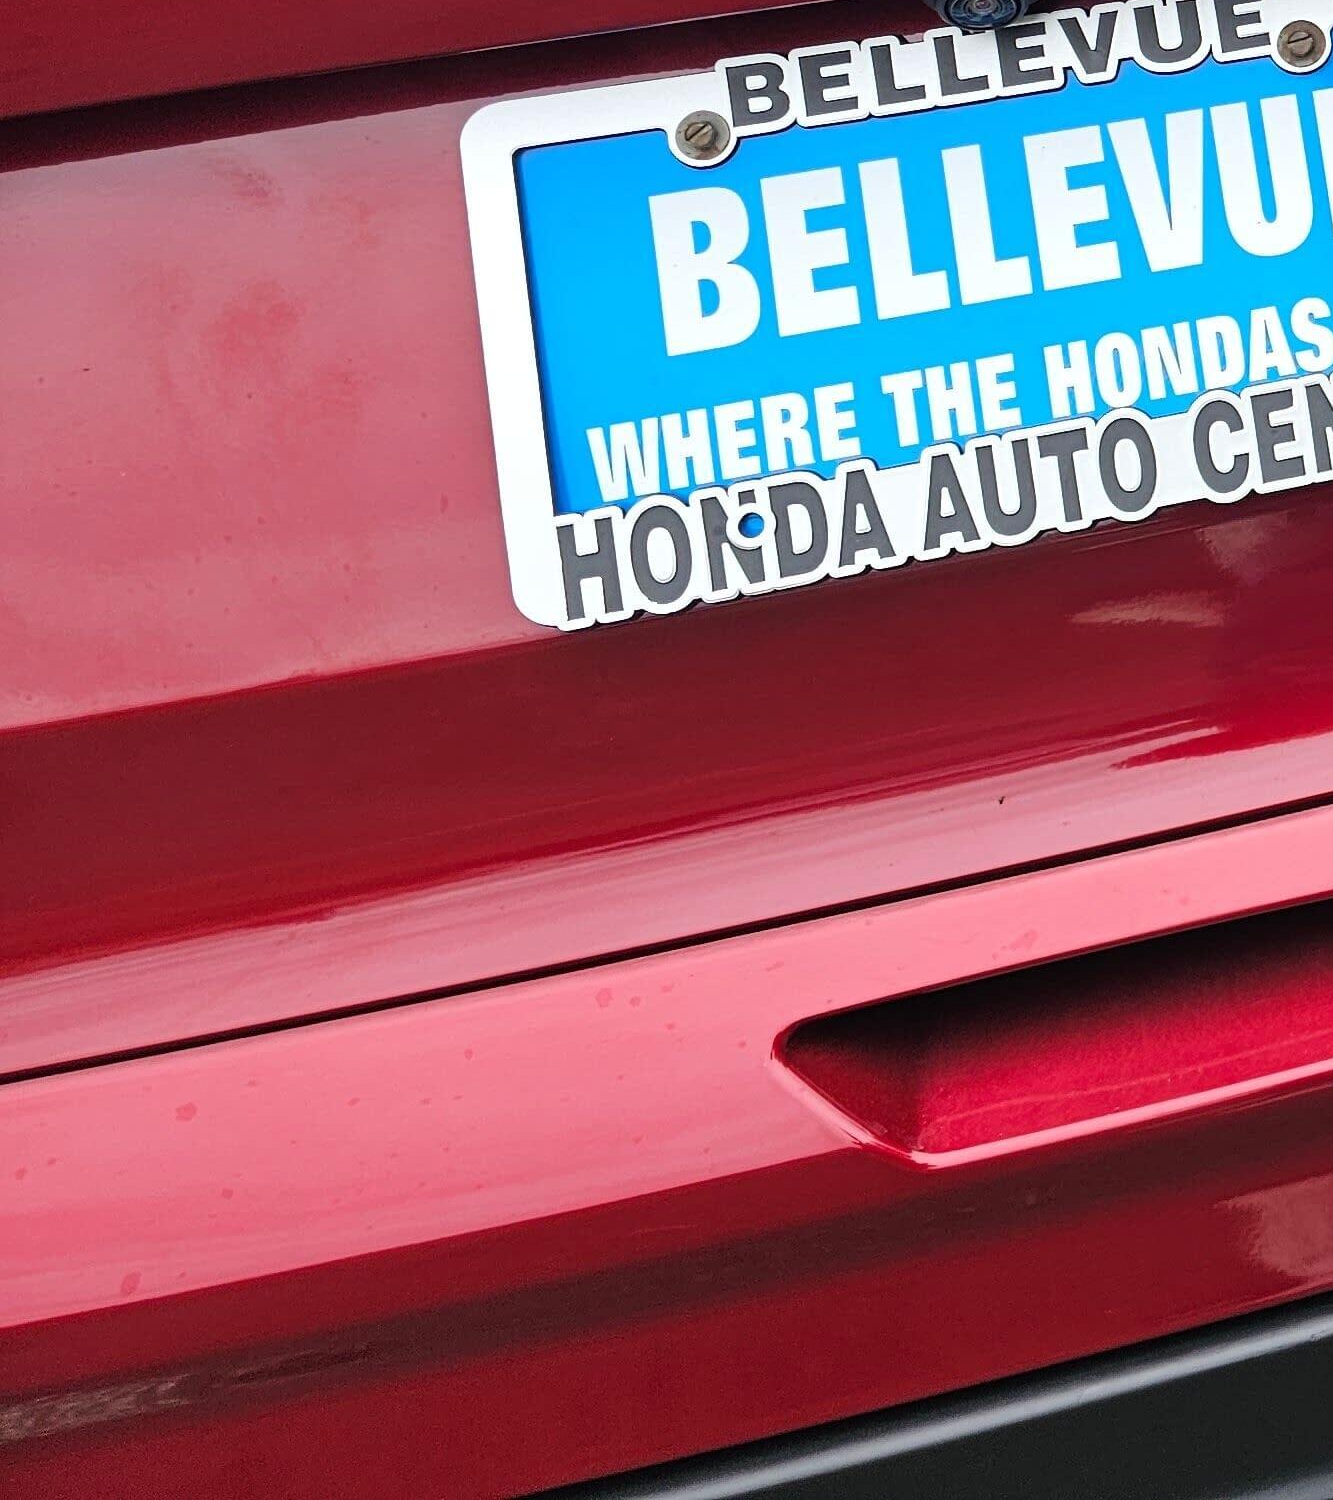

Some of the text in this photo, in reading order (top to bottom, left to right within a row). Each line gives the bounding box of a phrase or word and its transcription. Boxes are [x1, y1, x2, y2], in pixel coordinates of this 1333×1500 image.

[587, 382, 861, 503] WHERE
[881, 354, 1022, 450] THE
[556, 466, 886, 621] HONDA
[921, 419, 1158, 550] AUTO
